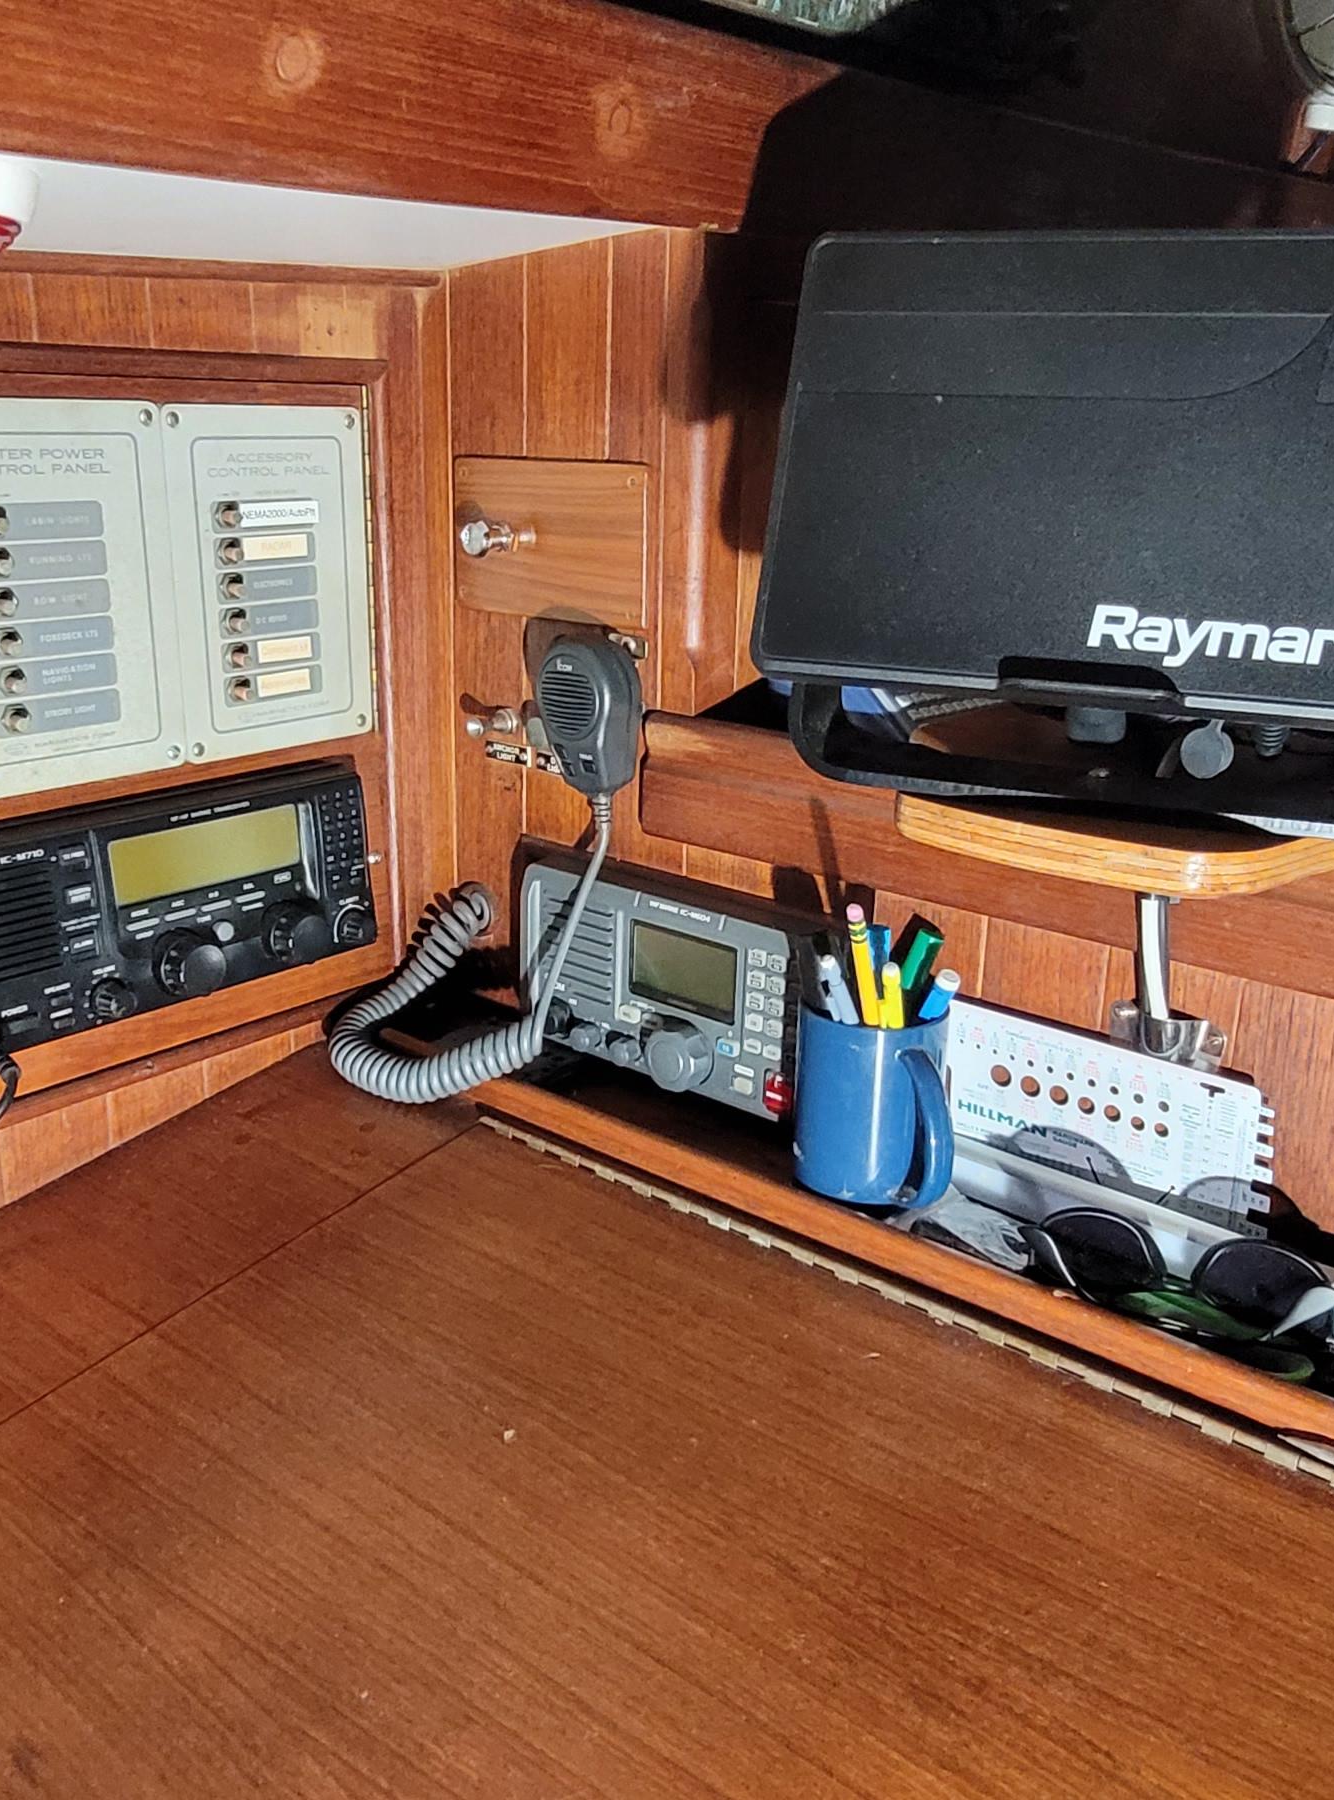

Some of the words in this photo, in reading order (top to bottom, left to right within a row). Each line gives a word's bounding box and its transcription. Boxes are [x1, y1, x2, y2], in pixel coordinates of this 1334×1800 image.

[39, 447, 105, 460] POWER
[226, 452, 313, 463] ACCESSORY
[52, 463, 111, 475] PANEL
[207, 466, 279, 478] CONTROL
[283, 465, 331, 476] PANEL
[41, 663, 97, 677] NAVIGATION
[957, 1099, 1048, 1138] HILLMAN
